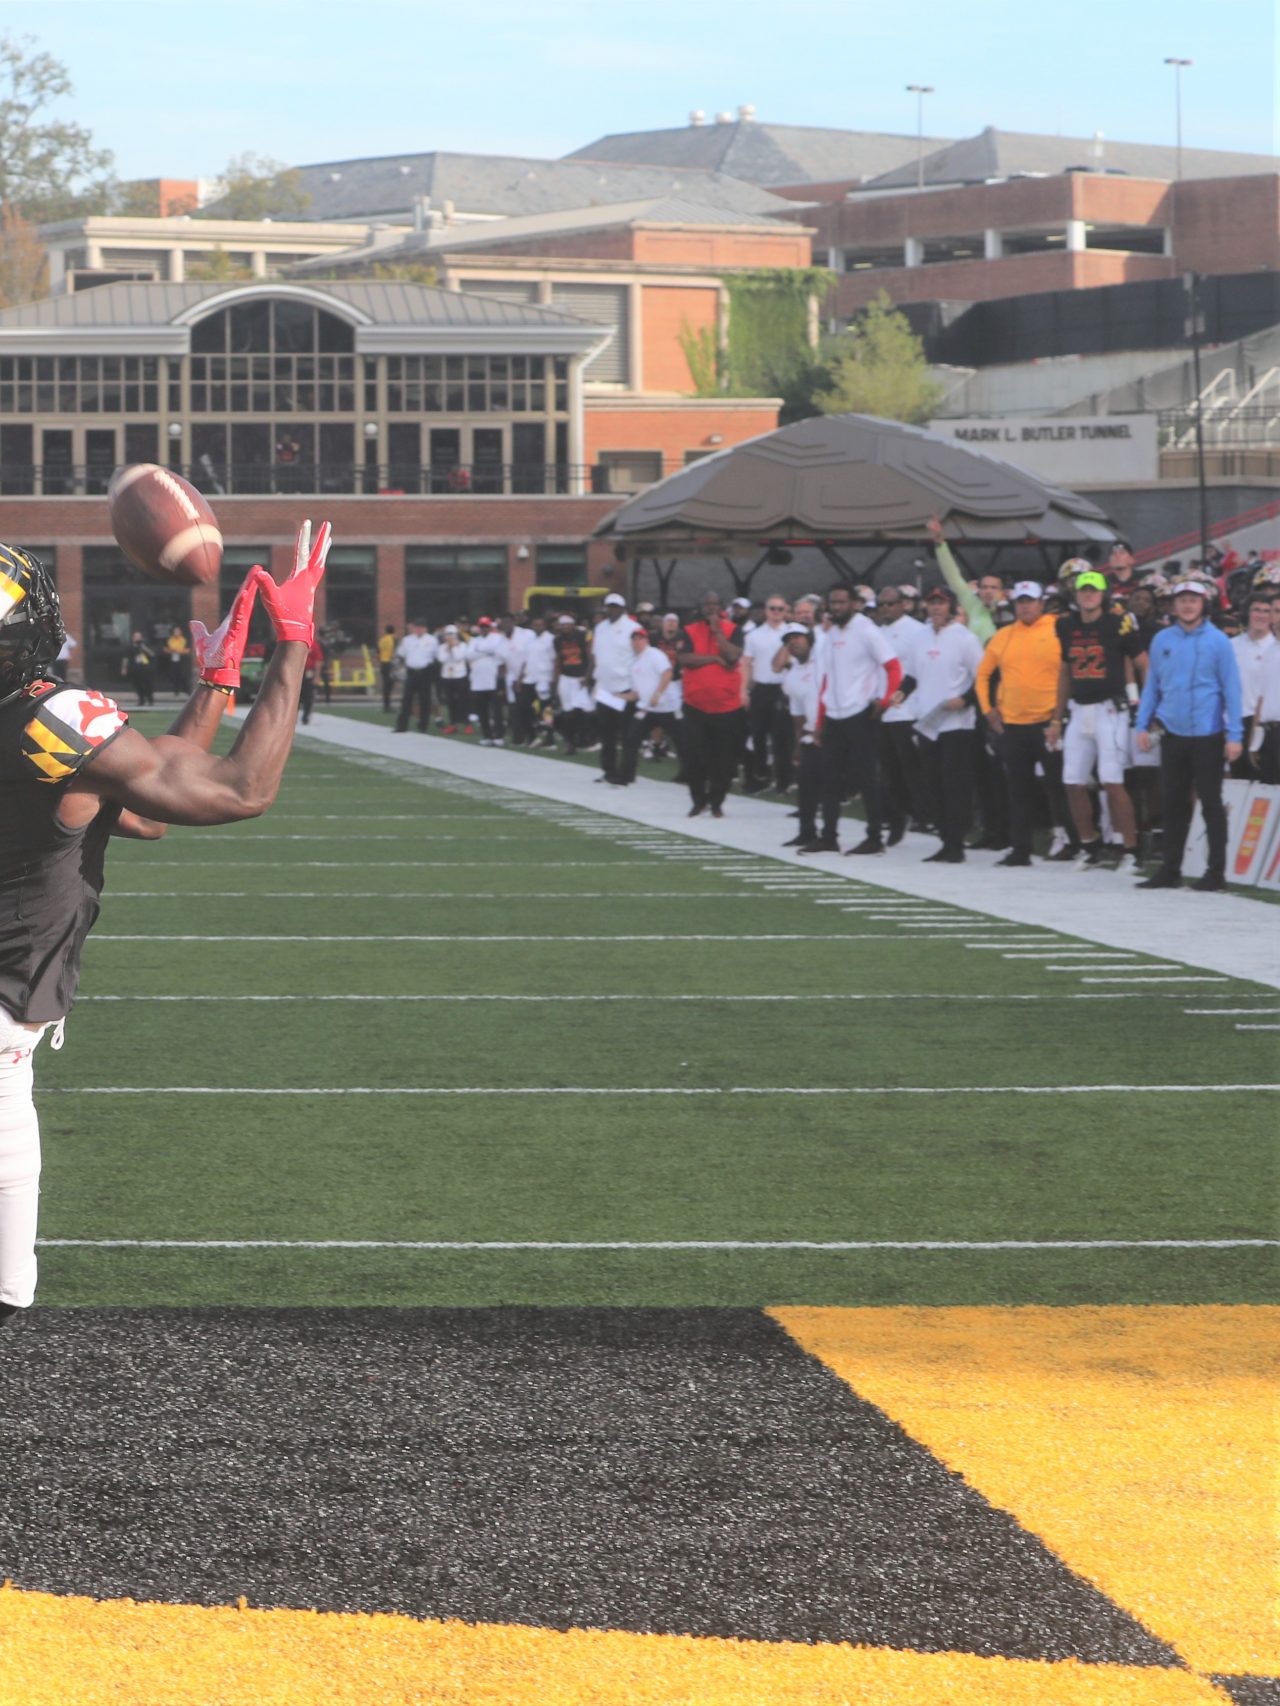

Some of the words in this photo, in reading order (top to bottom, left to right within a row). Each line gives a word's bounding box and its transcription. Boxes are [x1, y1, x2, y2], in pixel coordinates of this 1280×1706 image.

[955, 427, 1000, 442] MARK
[1021, 426, 1077, 441] BUTLER
[1080, 424, 1132, 440] TUNNEL
[1069, 645, 1107, 679] 22
